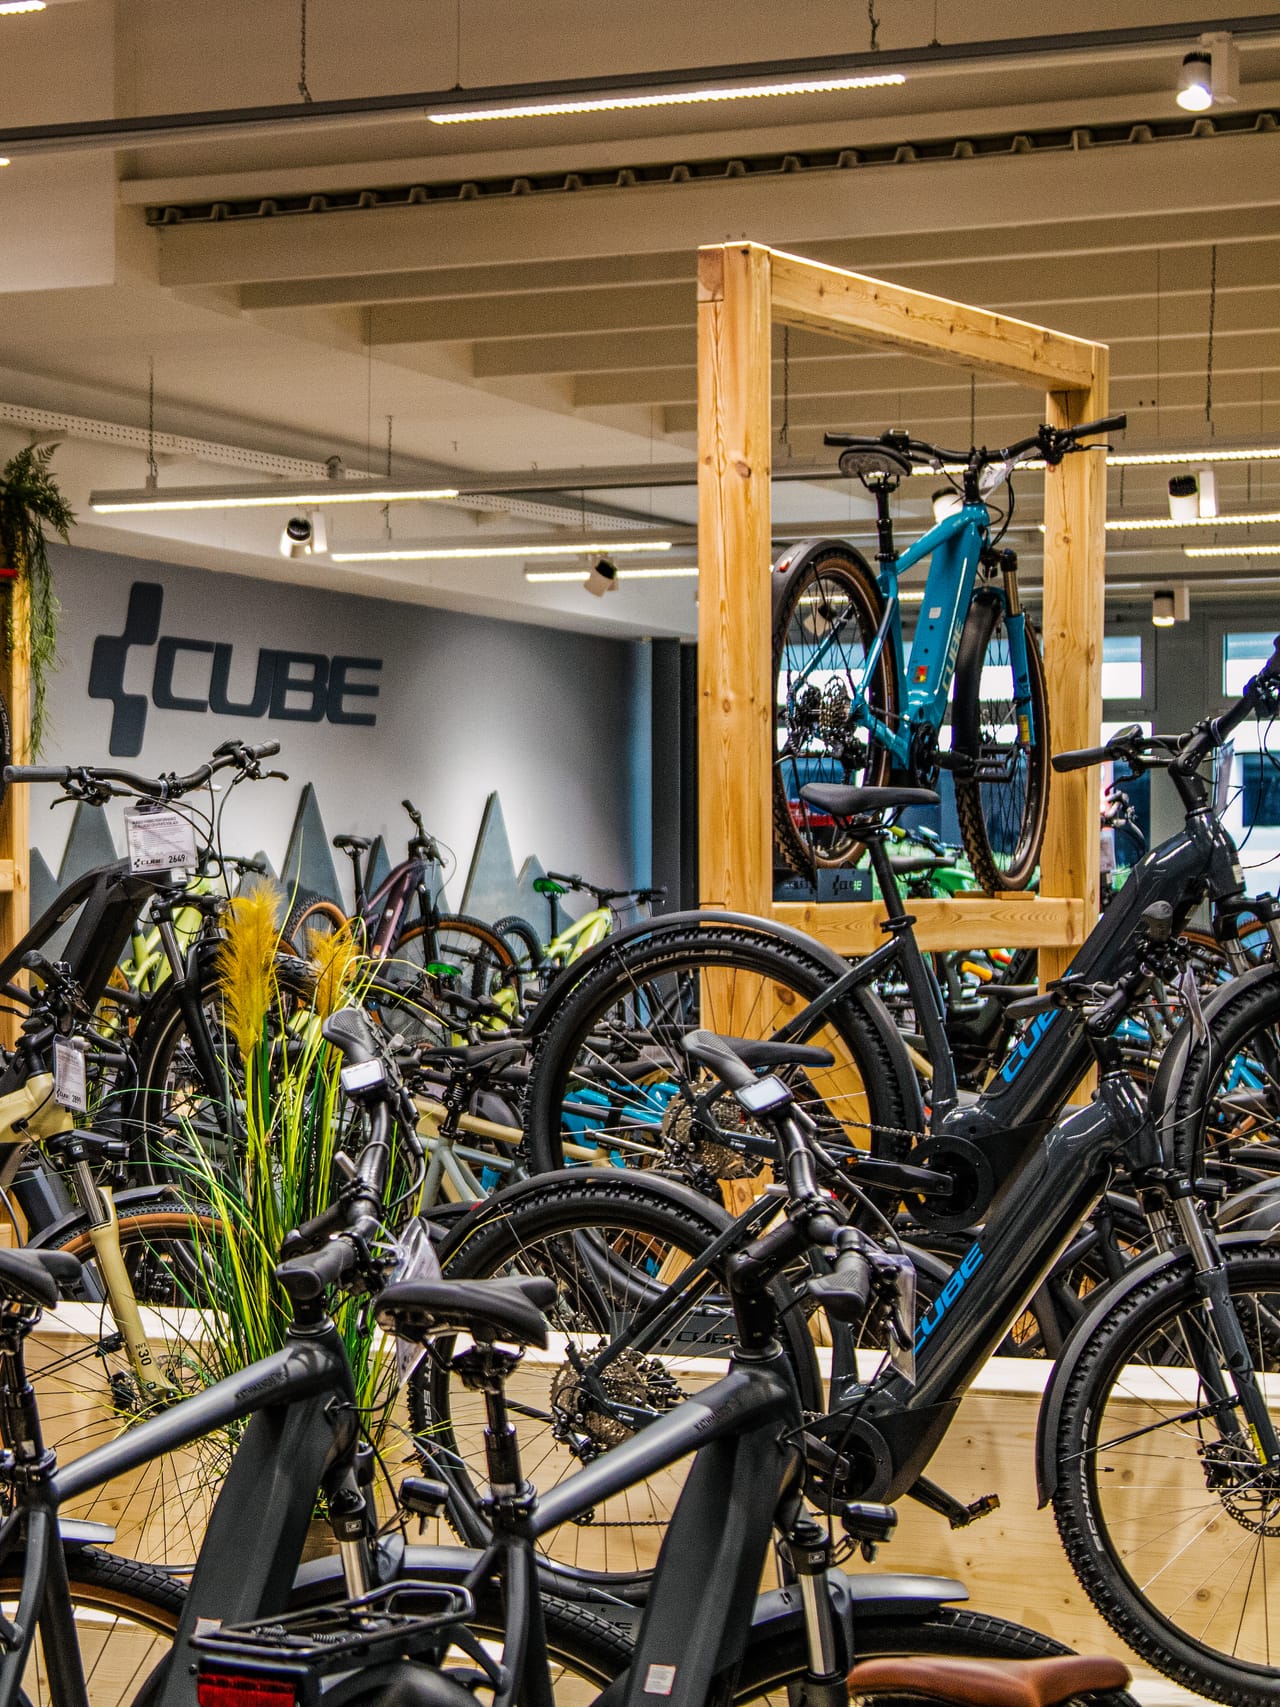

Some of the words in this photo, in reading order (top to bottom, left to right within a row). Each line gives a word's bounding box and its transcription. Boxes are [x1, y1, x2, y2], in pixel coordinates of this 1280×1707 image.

[152, 636, 383, 726] CUBE
[168, 854, 186, 864] 2649
[616, 949, 733, 982] SCHWALBE
[1080, 1407, 1104, 1551] SCHWALBE
